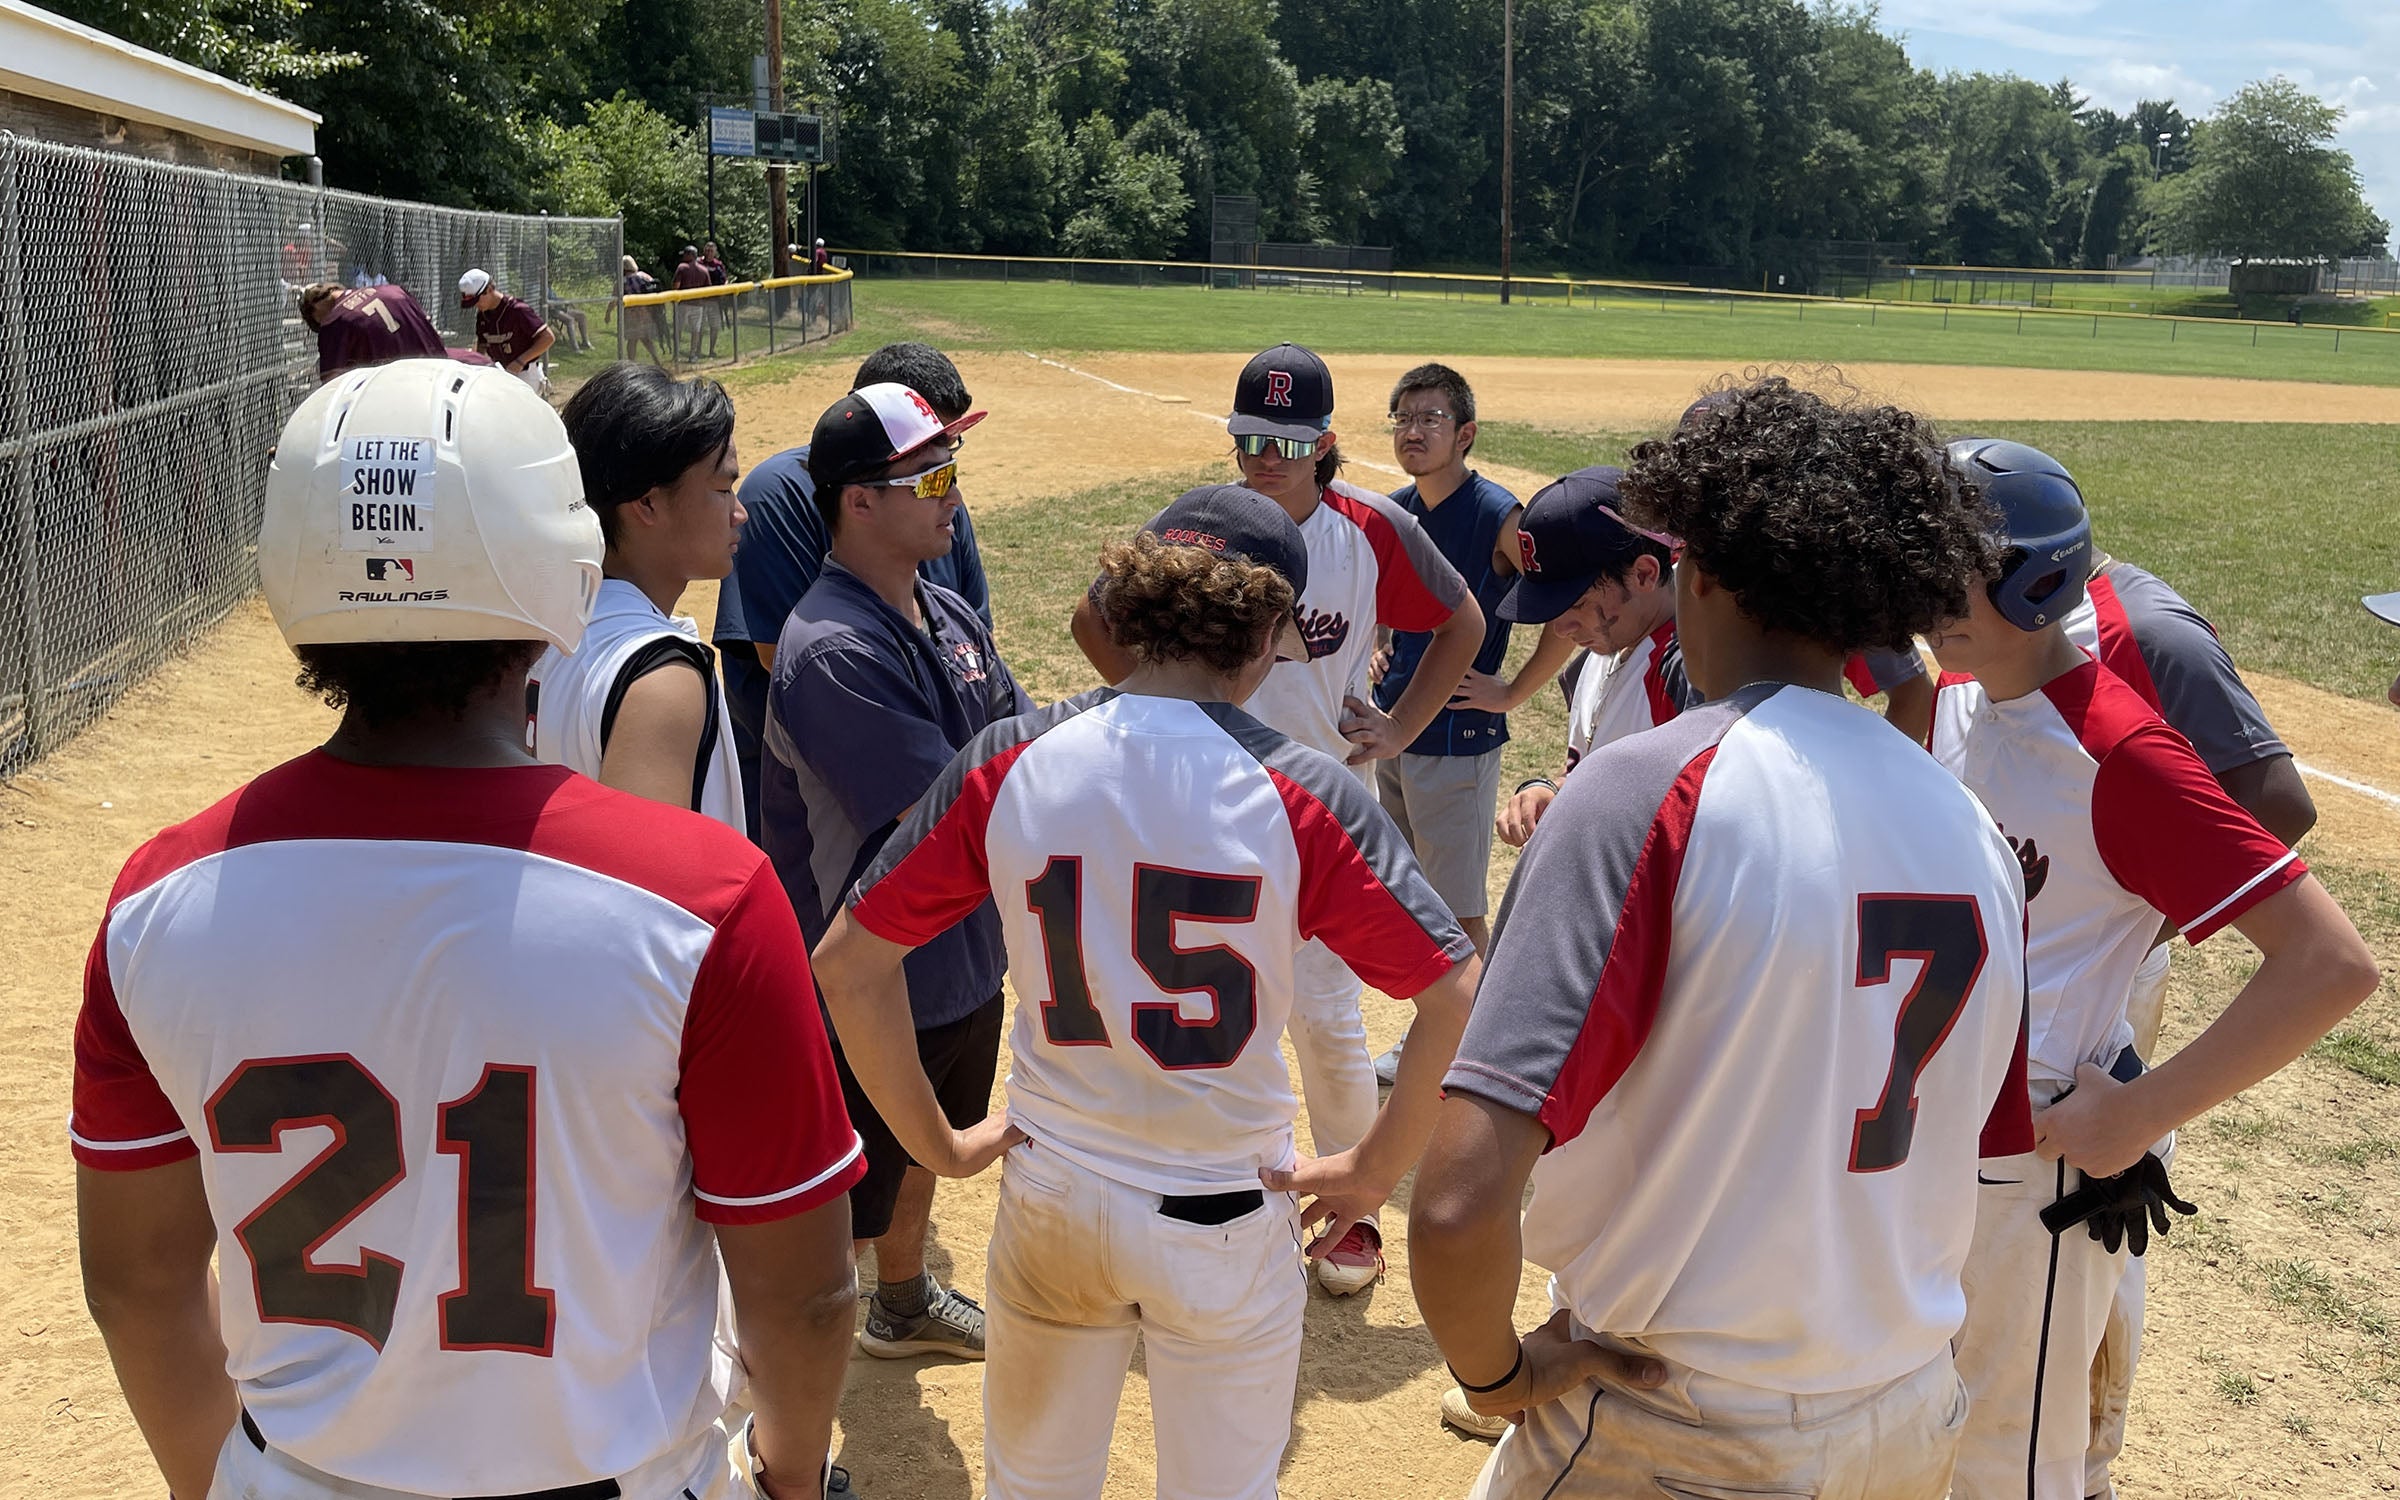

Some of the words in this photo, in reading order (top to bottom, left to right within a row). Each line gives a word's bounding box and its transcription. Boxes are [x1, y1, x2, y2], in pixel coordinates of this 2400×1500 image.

[361, 297, 400, 333] 7
[1264, 370, 1292, 407] R
[355, 441, 384, 460] LET
[389, 441, 420, 460] THE
[352, 467, 417, 496] SHOW
[352, 503, 424, 532] BEGIN.
[1516, 528, 1542, 573] R
[338, 589, 449, 602] RAWLINGS
[1025, 855, 1263, 1070] 15
[1847, 892, 1990, 1173] 7
[203, 1052, 556, 1358] 21
